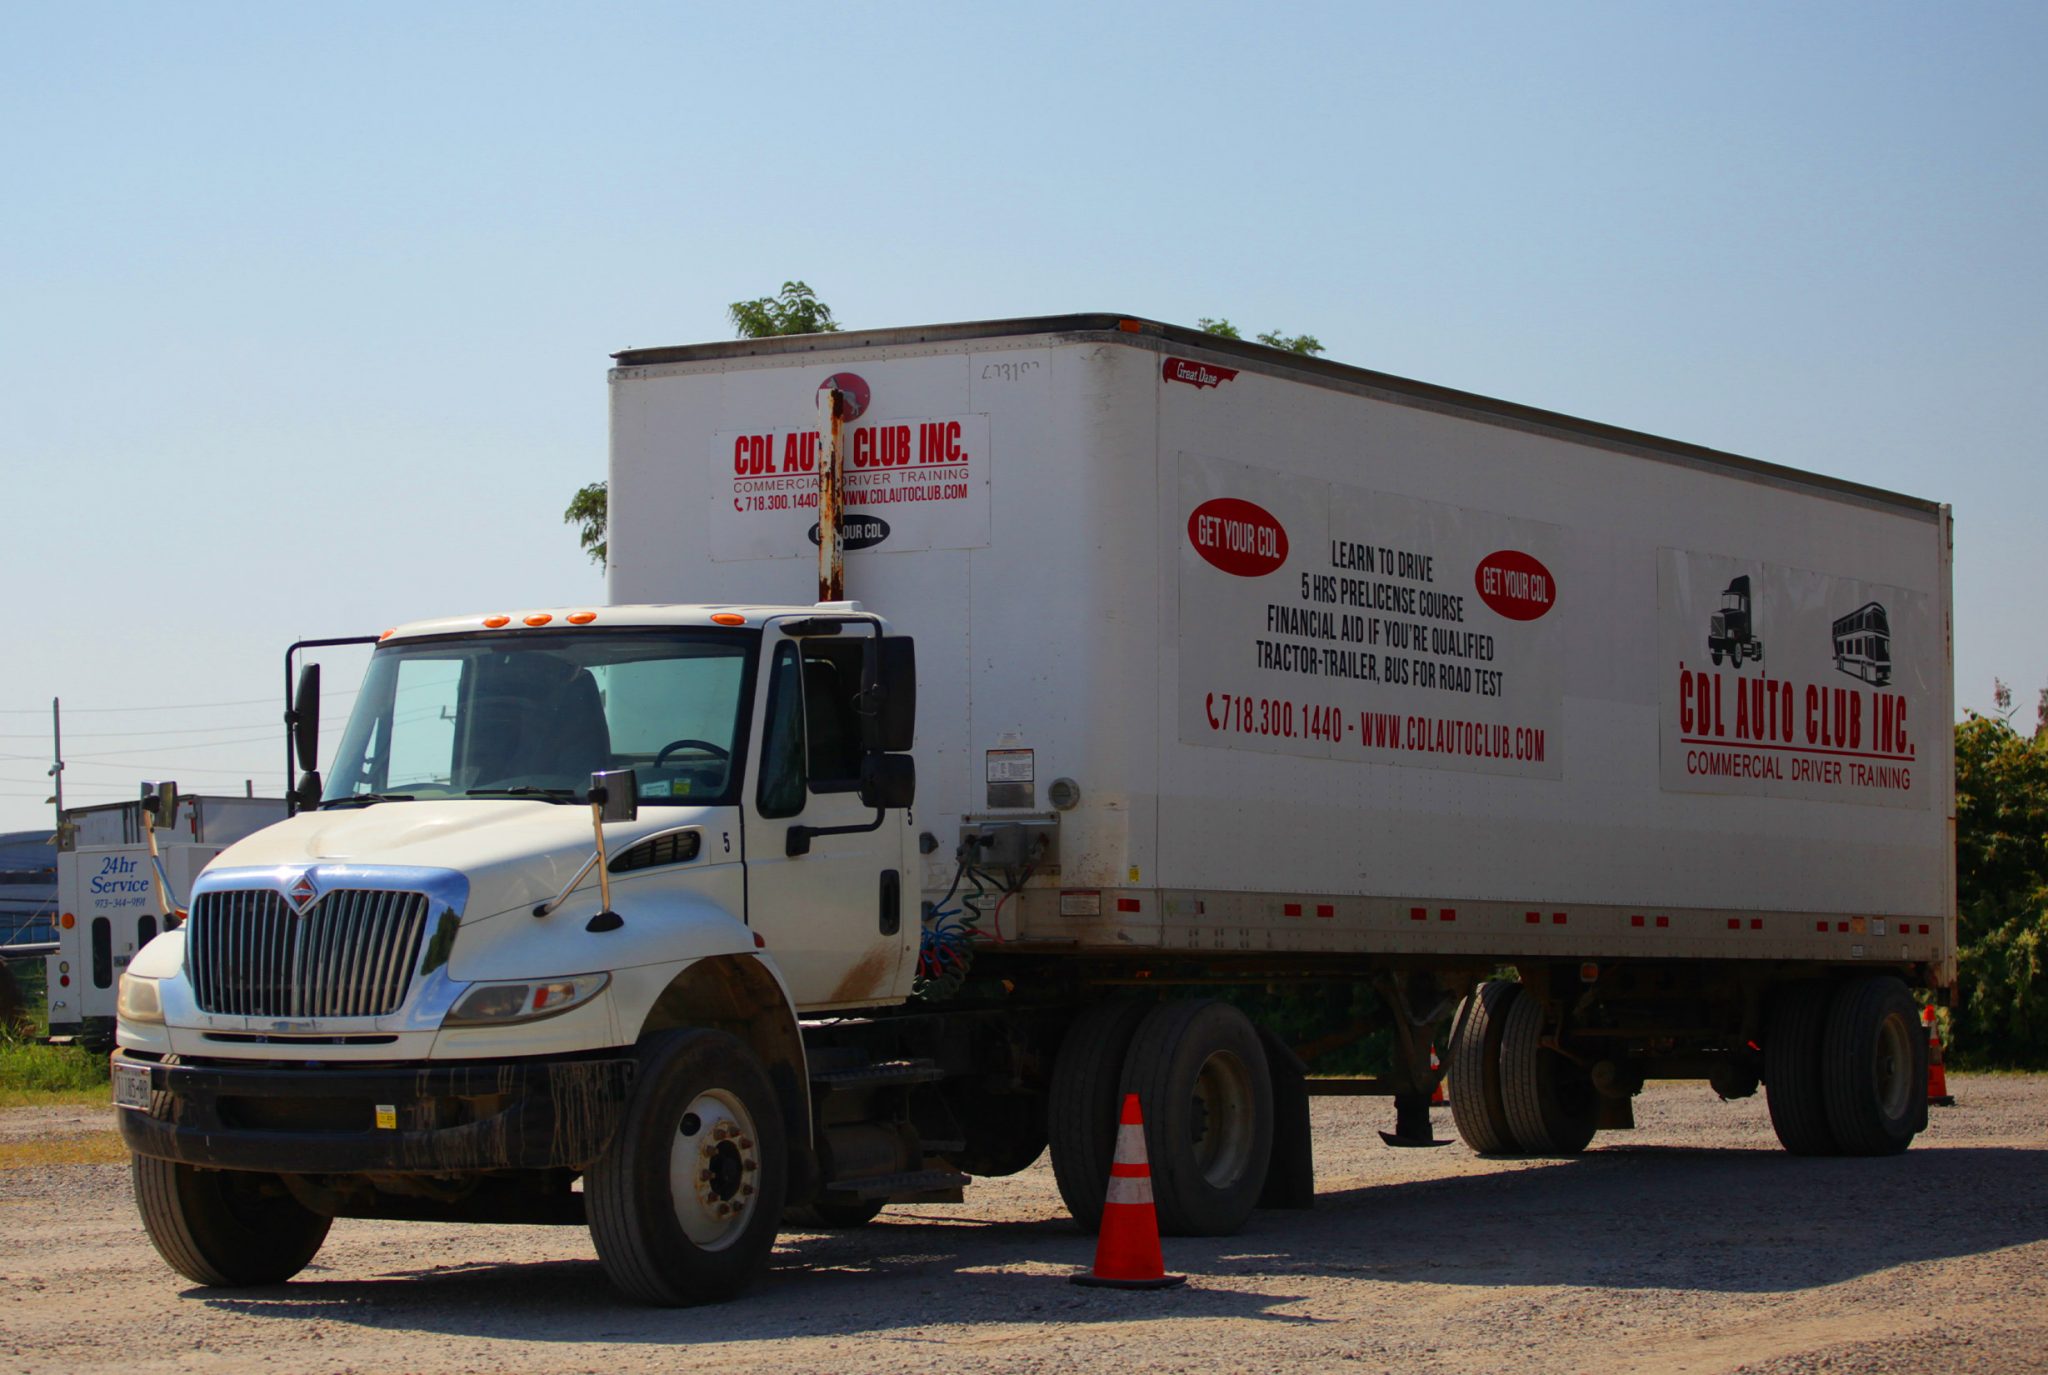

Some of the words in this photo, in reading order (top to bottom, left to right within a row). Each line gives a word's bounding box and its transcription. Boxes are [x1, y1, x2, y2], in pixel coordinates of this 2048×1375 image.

[1177, 362, 1198, 380] Great
[1199, 367, 1217, 384] Dane
[734, 434, 776, 474] CDL
[783, 431, 844, 473] AU
[853, 425, 911, 468] CLUB
[919, 421, 968, 464] INC.
[734, 479, 820, 494] COMMERCIA
[899, 468, 969, 483] TRAINING
[745, 492, 818, 512] 718.300.1440
[842, 524, 863, 540] OUR
[865, 523, 884, 538] CDL
[1198, 514, 1222, 548] GET
[1223, 519, 1255, 554] YOUR
[1258, 525, 1280, 559] CDL
[1332, 539, 1375, 573] LEARN
[1378, 547, 1394, 576] TO
[1398, 551, 1433, 583] DRIVE
[1301, 572, 1310, 600] 5
[1313, 574, 1337, 604] HRS
[1340, 578, 1416, 615] PRELICENSE
[1419, 590, 1464, 623] COURSE
[1483, 566, 1502, 596] GET
[1503, 569, 1529, 600] YOUR
[1530, 574, 1549, 604] CDL
[1267, 604, 1337, 640] FINANCIAL
[1340, 613, 1364, 643] AID
[1368, 618, 1380, 645] IF
[1384, 619, 1428, 653] YOU'RE
[1431, 627, 1494, 662] QUALIFIED
[1256, 640, 1381, 685] TRACTOR-TRAILER,
[1384, 656, 1409, 685] BUS
[1413, 659, 1436, 689] FOR
[1439, 663, 1471, 694] ROAD
[1475, 668, 1503, 697] TEST
[1221, 693, 1342, 743] 718.300.1440
[1360, 711, 1545, 762] WWW.CDLAUTOCLUB.COM
[1680, 667, 1725, 737] CDL
[1736, 675, 1793, 743] AUTO
[1806, 683, 1861, 749] CLUB
[1873, 692, 1915, 755] INC.
[1687, 750, 1783, 780] COMMERCIAL
[1791, 758, 1842, 785] DRIVER
[1848, 763, 1911, 790] TRAINING
[723, 832, 730, 853] 5
[90, 875, 149, 894] Service
